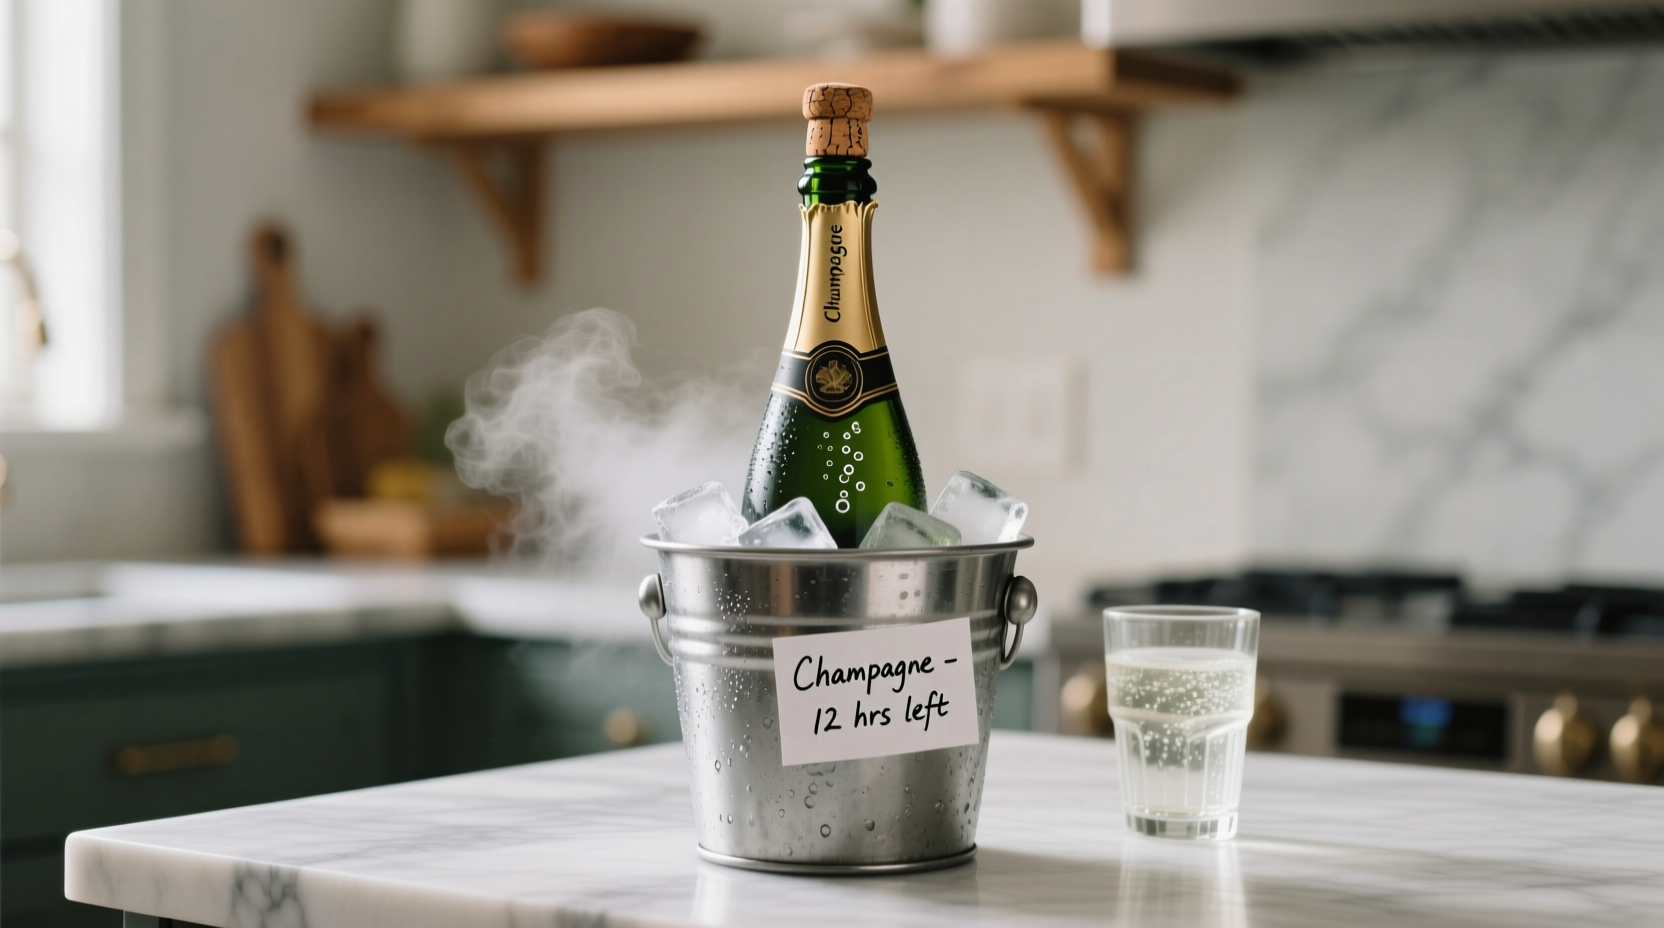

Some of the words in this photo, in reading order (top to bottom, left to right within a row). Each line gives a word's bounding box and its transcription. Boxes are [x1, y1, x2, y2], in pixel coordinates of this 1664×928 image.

[794, 655, 934, 695] Champagne
[814, 707, 842, 735] 12
[854, 700, 891, 728] hrs
[905, 690, 950, 732] left
